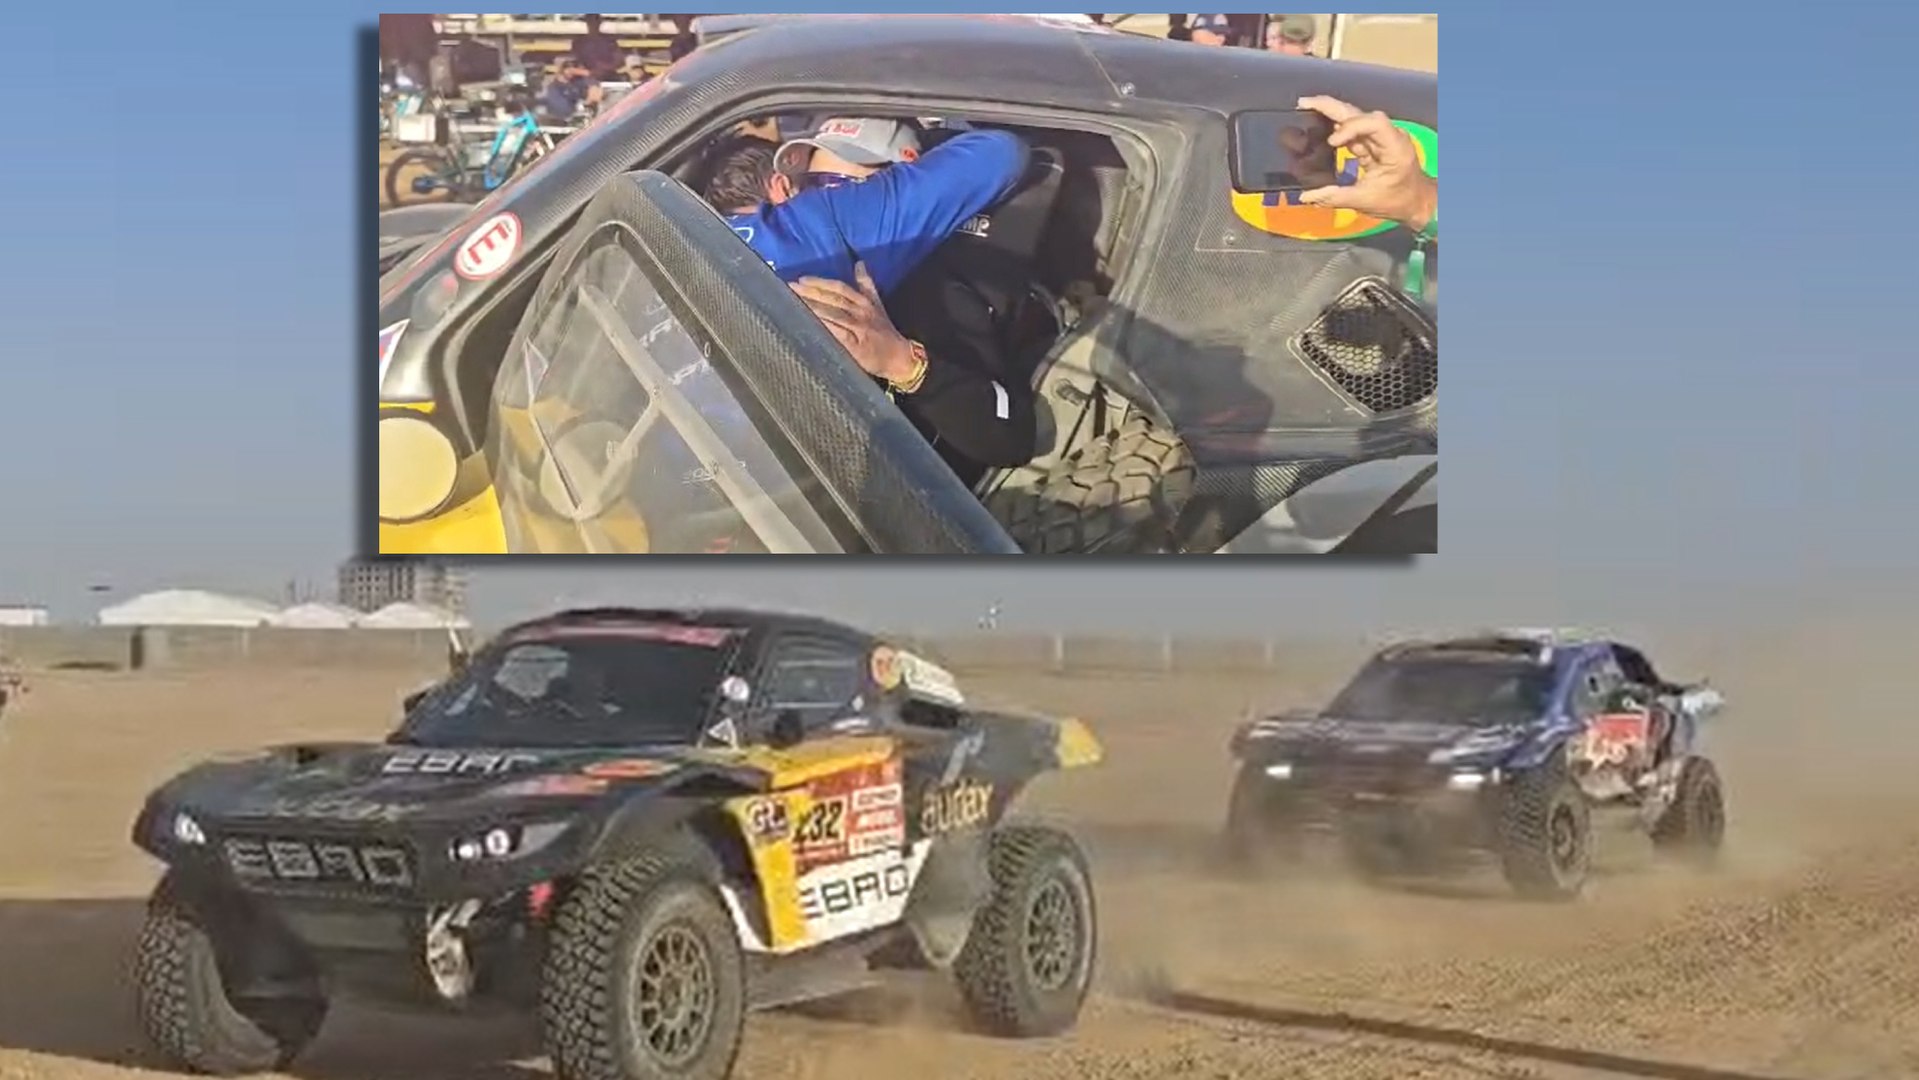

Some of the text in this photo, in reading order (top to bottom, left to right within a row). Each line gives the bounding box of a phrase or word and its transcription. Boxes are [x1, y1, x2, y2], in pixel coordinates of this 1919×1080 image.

[467, 222, 509, 265] E
[793, 801, 843, 843] 232
[801, 865, 909, 918] EBRO
